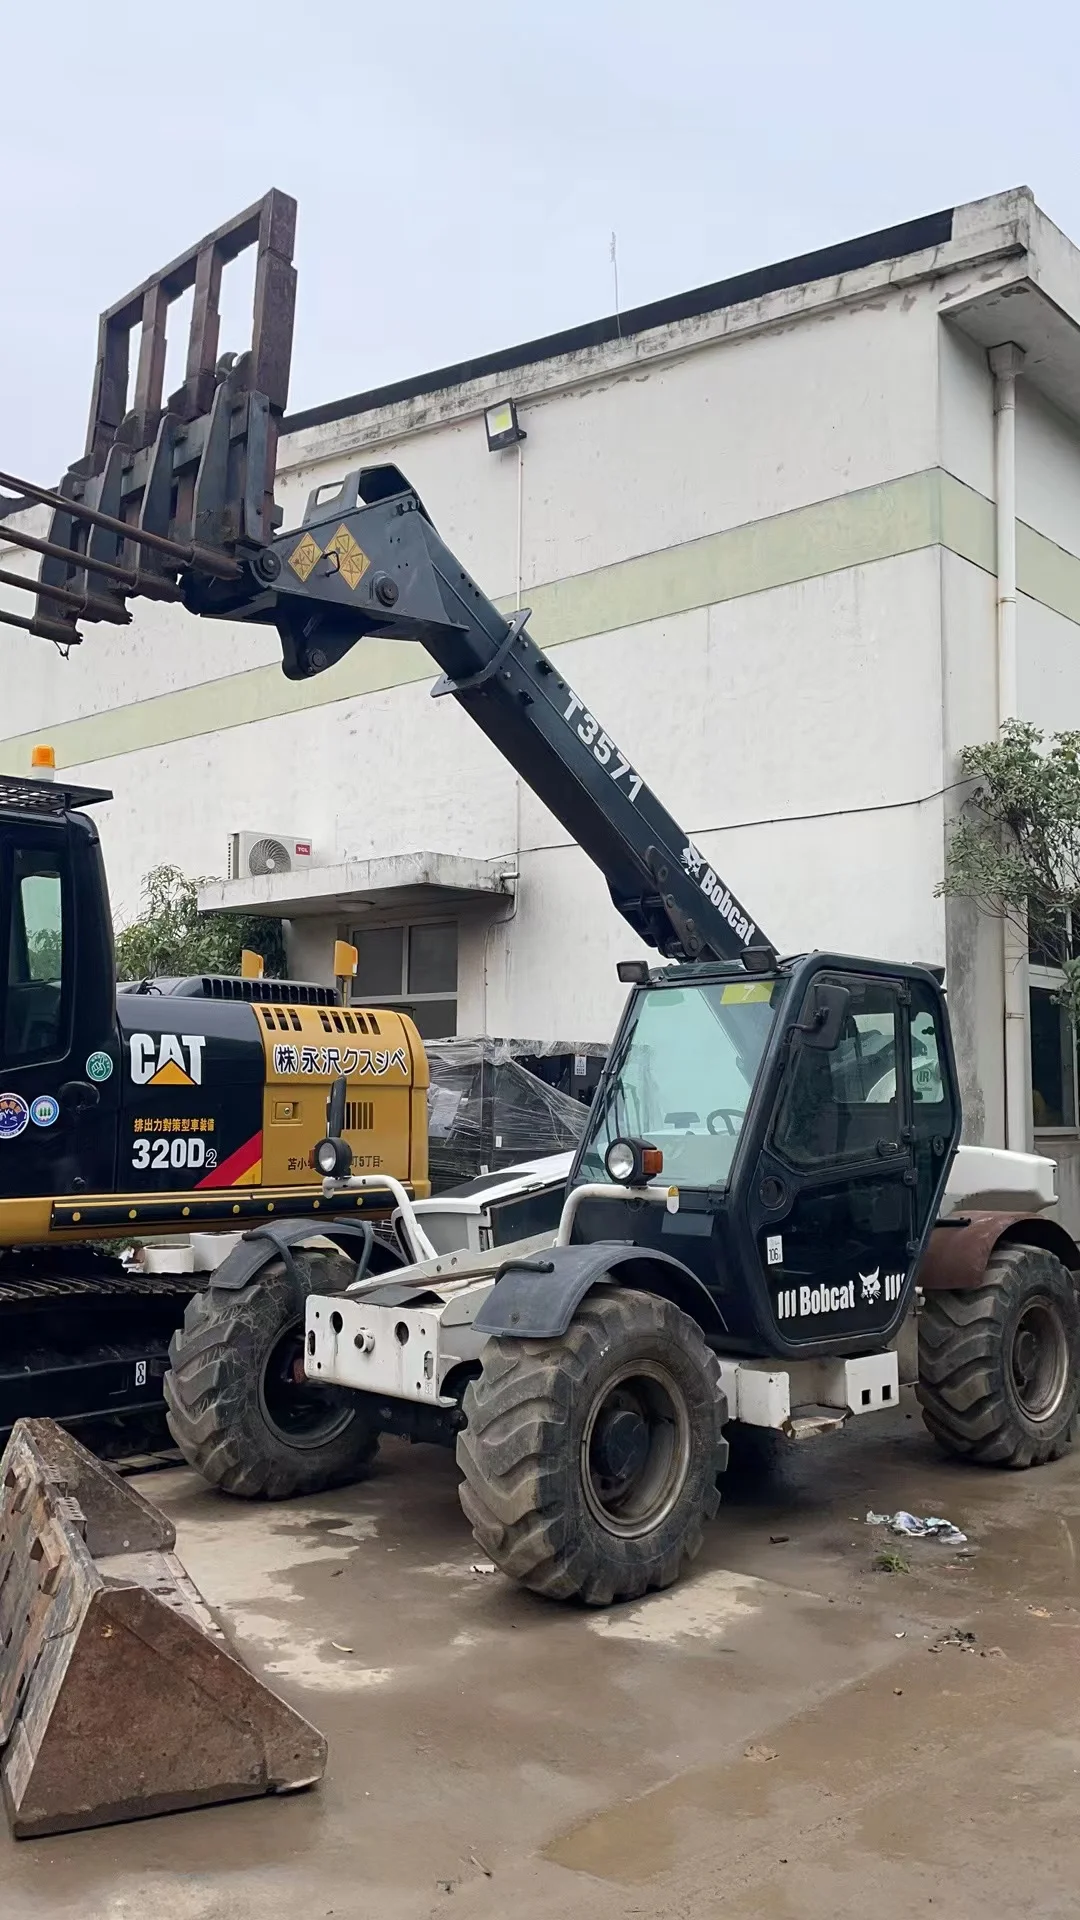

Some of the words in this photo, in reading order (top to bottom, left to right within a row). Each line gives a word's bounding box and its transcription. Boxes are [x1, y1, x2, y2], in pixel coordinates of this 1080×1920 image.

[563, 690, 643, 802] T3571
[700, 867, 755, 945] Bobcat
[129, 1033, 206, 1085] CAT
[131, 1138, 218, 1169] 320D2
[800, 1280, 855, 1316] Bobcat
